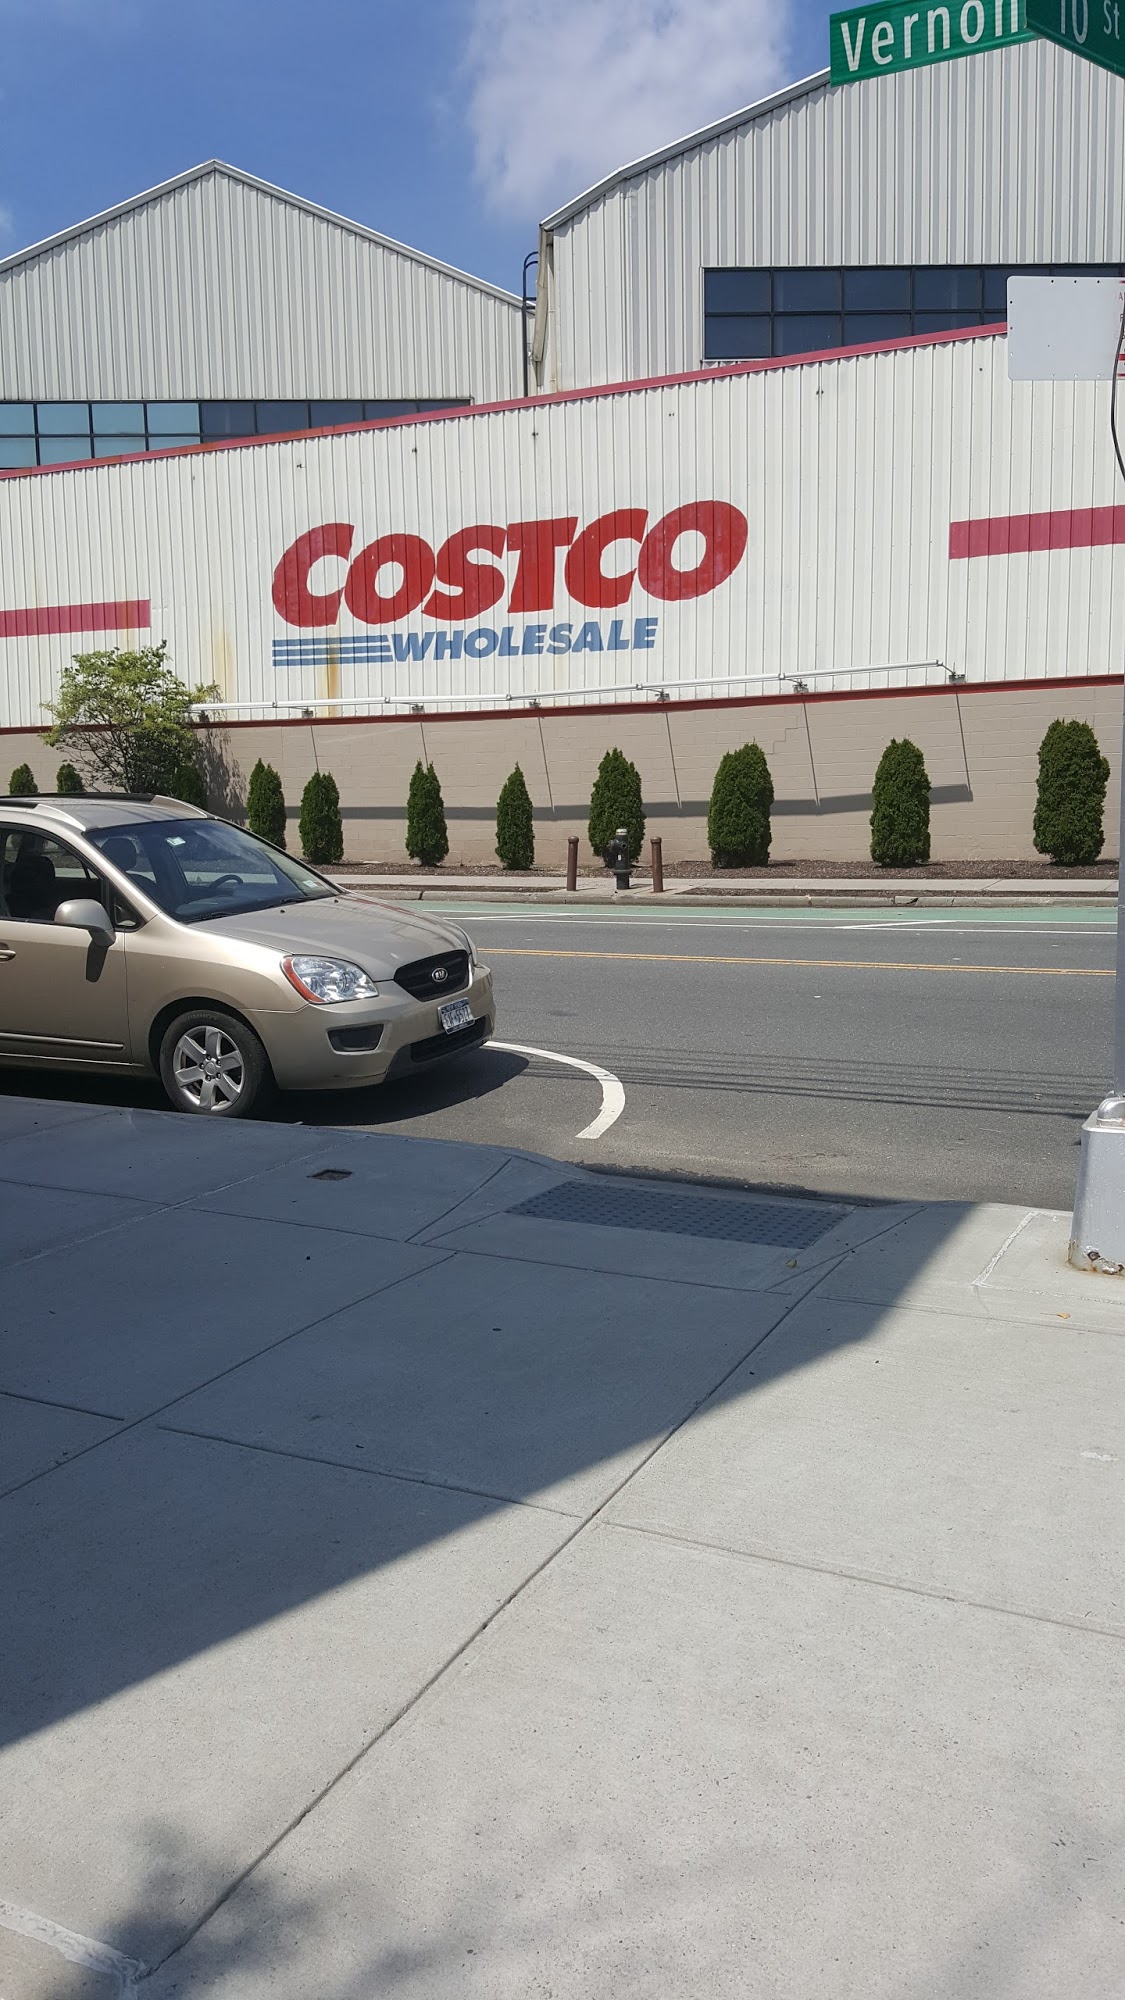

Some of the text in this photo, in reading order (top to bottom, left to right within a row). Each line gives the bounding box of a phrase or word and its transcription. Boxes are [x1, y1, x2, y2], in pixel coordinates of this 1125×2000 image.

[840, 0, 1019, 72] Vernon
[1060, 0, 1120, 44] 10 St
[271, 499, 748, 628] COSTCO
[390, 617, 659, 662] WHOLESALE
